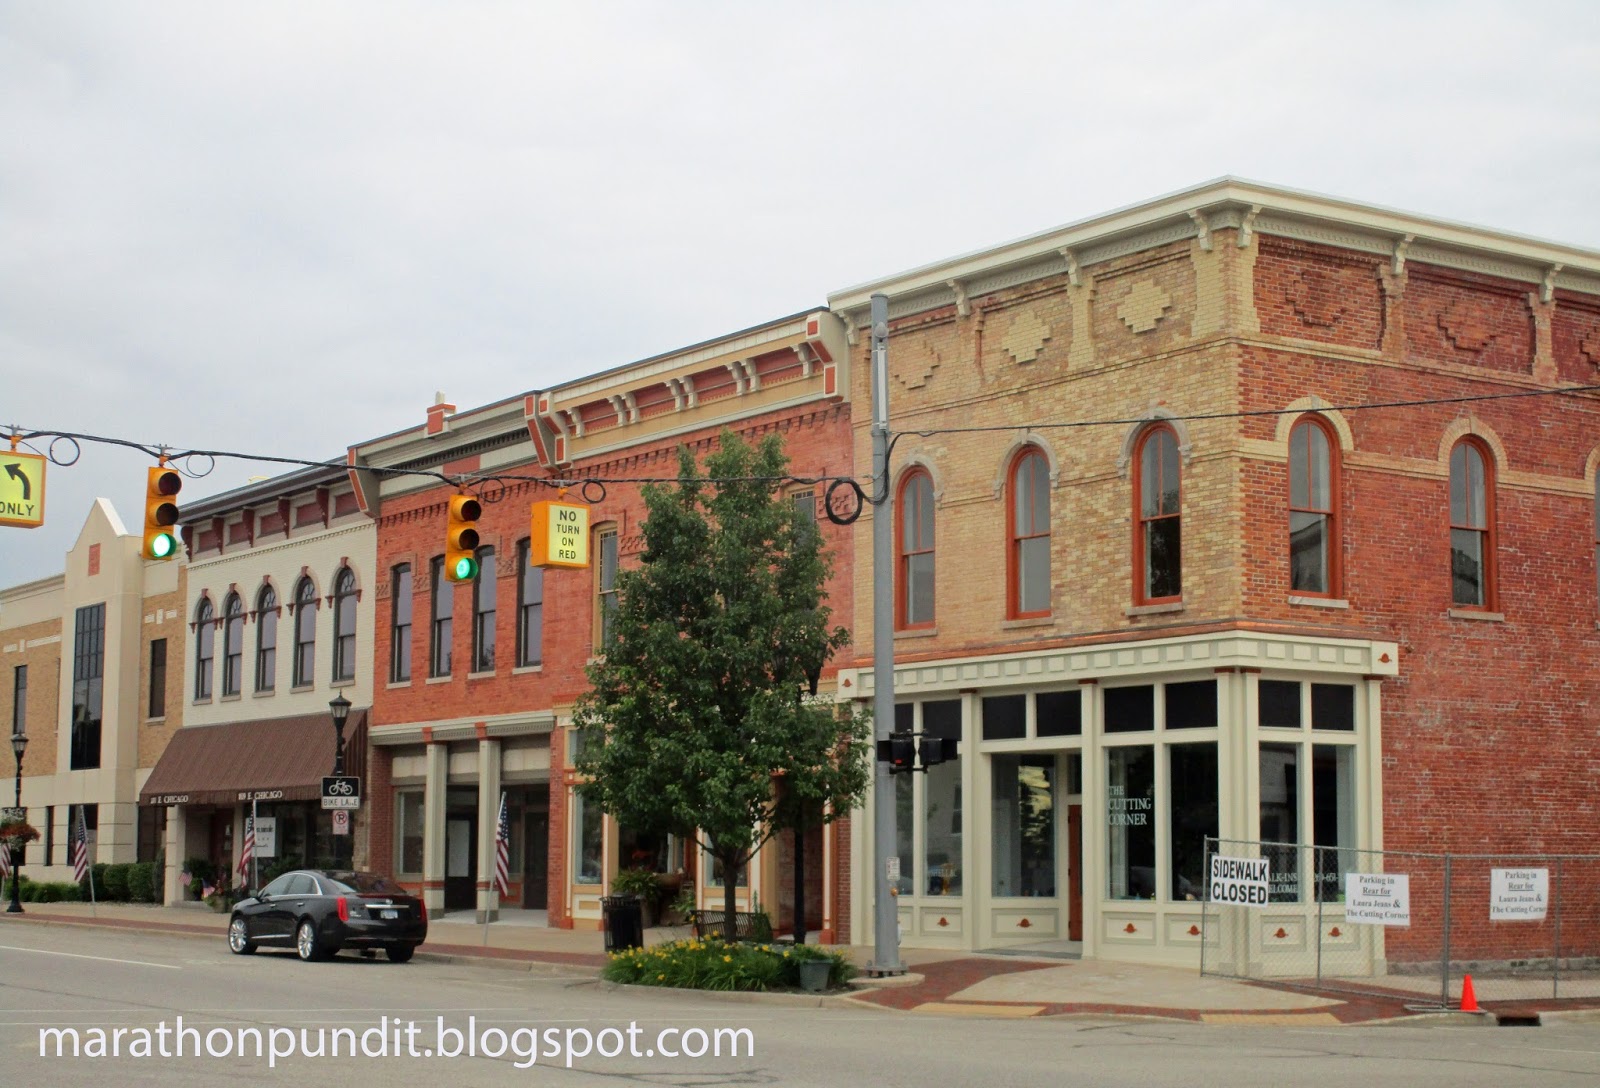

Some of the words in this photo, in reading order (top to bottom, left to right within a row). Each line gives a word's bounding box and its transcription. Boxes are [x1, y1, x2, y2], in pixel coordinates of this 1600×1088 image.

[0, 501, 35, 517] ONLY
[559, 509, 577, 522] NO
[556, 523, 580, 535] TURN
[561, 537, 574, 547] ON
[558, 549, 577, 560] RED
[254, 790, 283, 801] CHICAGO
[1109, 785, 1125, 796] THE
[163, 795, 189, 804] CHICAGO
[323, 798, 338, 806] BIKE
[1108, 797, 1152, 811] CUTTING
[1108, 812, 1148, 826] CORNER
[1213, 859, 1268, 882] SIDEWALK
[1505, 871, 1530, 880] Parking
[1531, 871, 1537, 879] in
[1359, 875, 1387, 886] Parking
[1387, 877, 1396, 885] in
[1212, 882, 1267, 904] CLOSED
[1362, 886, 1379, 895] Rear
[1380, 887, 1392, 895] for
[1535, 893, 1542, 902] &
[1352, 899, 1372, 907] Laura
[1373, 900, 1391, 908] Jeans
[1391, 899, 1401, 908] &
[1359, 910, 1384, 919] Cutting
[1384, 911, 1409, 919] Corner
